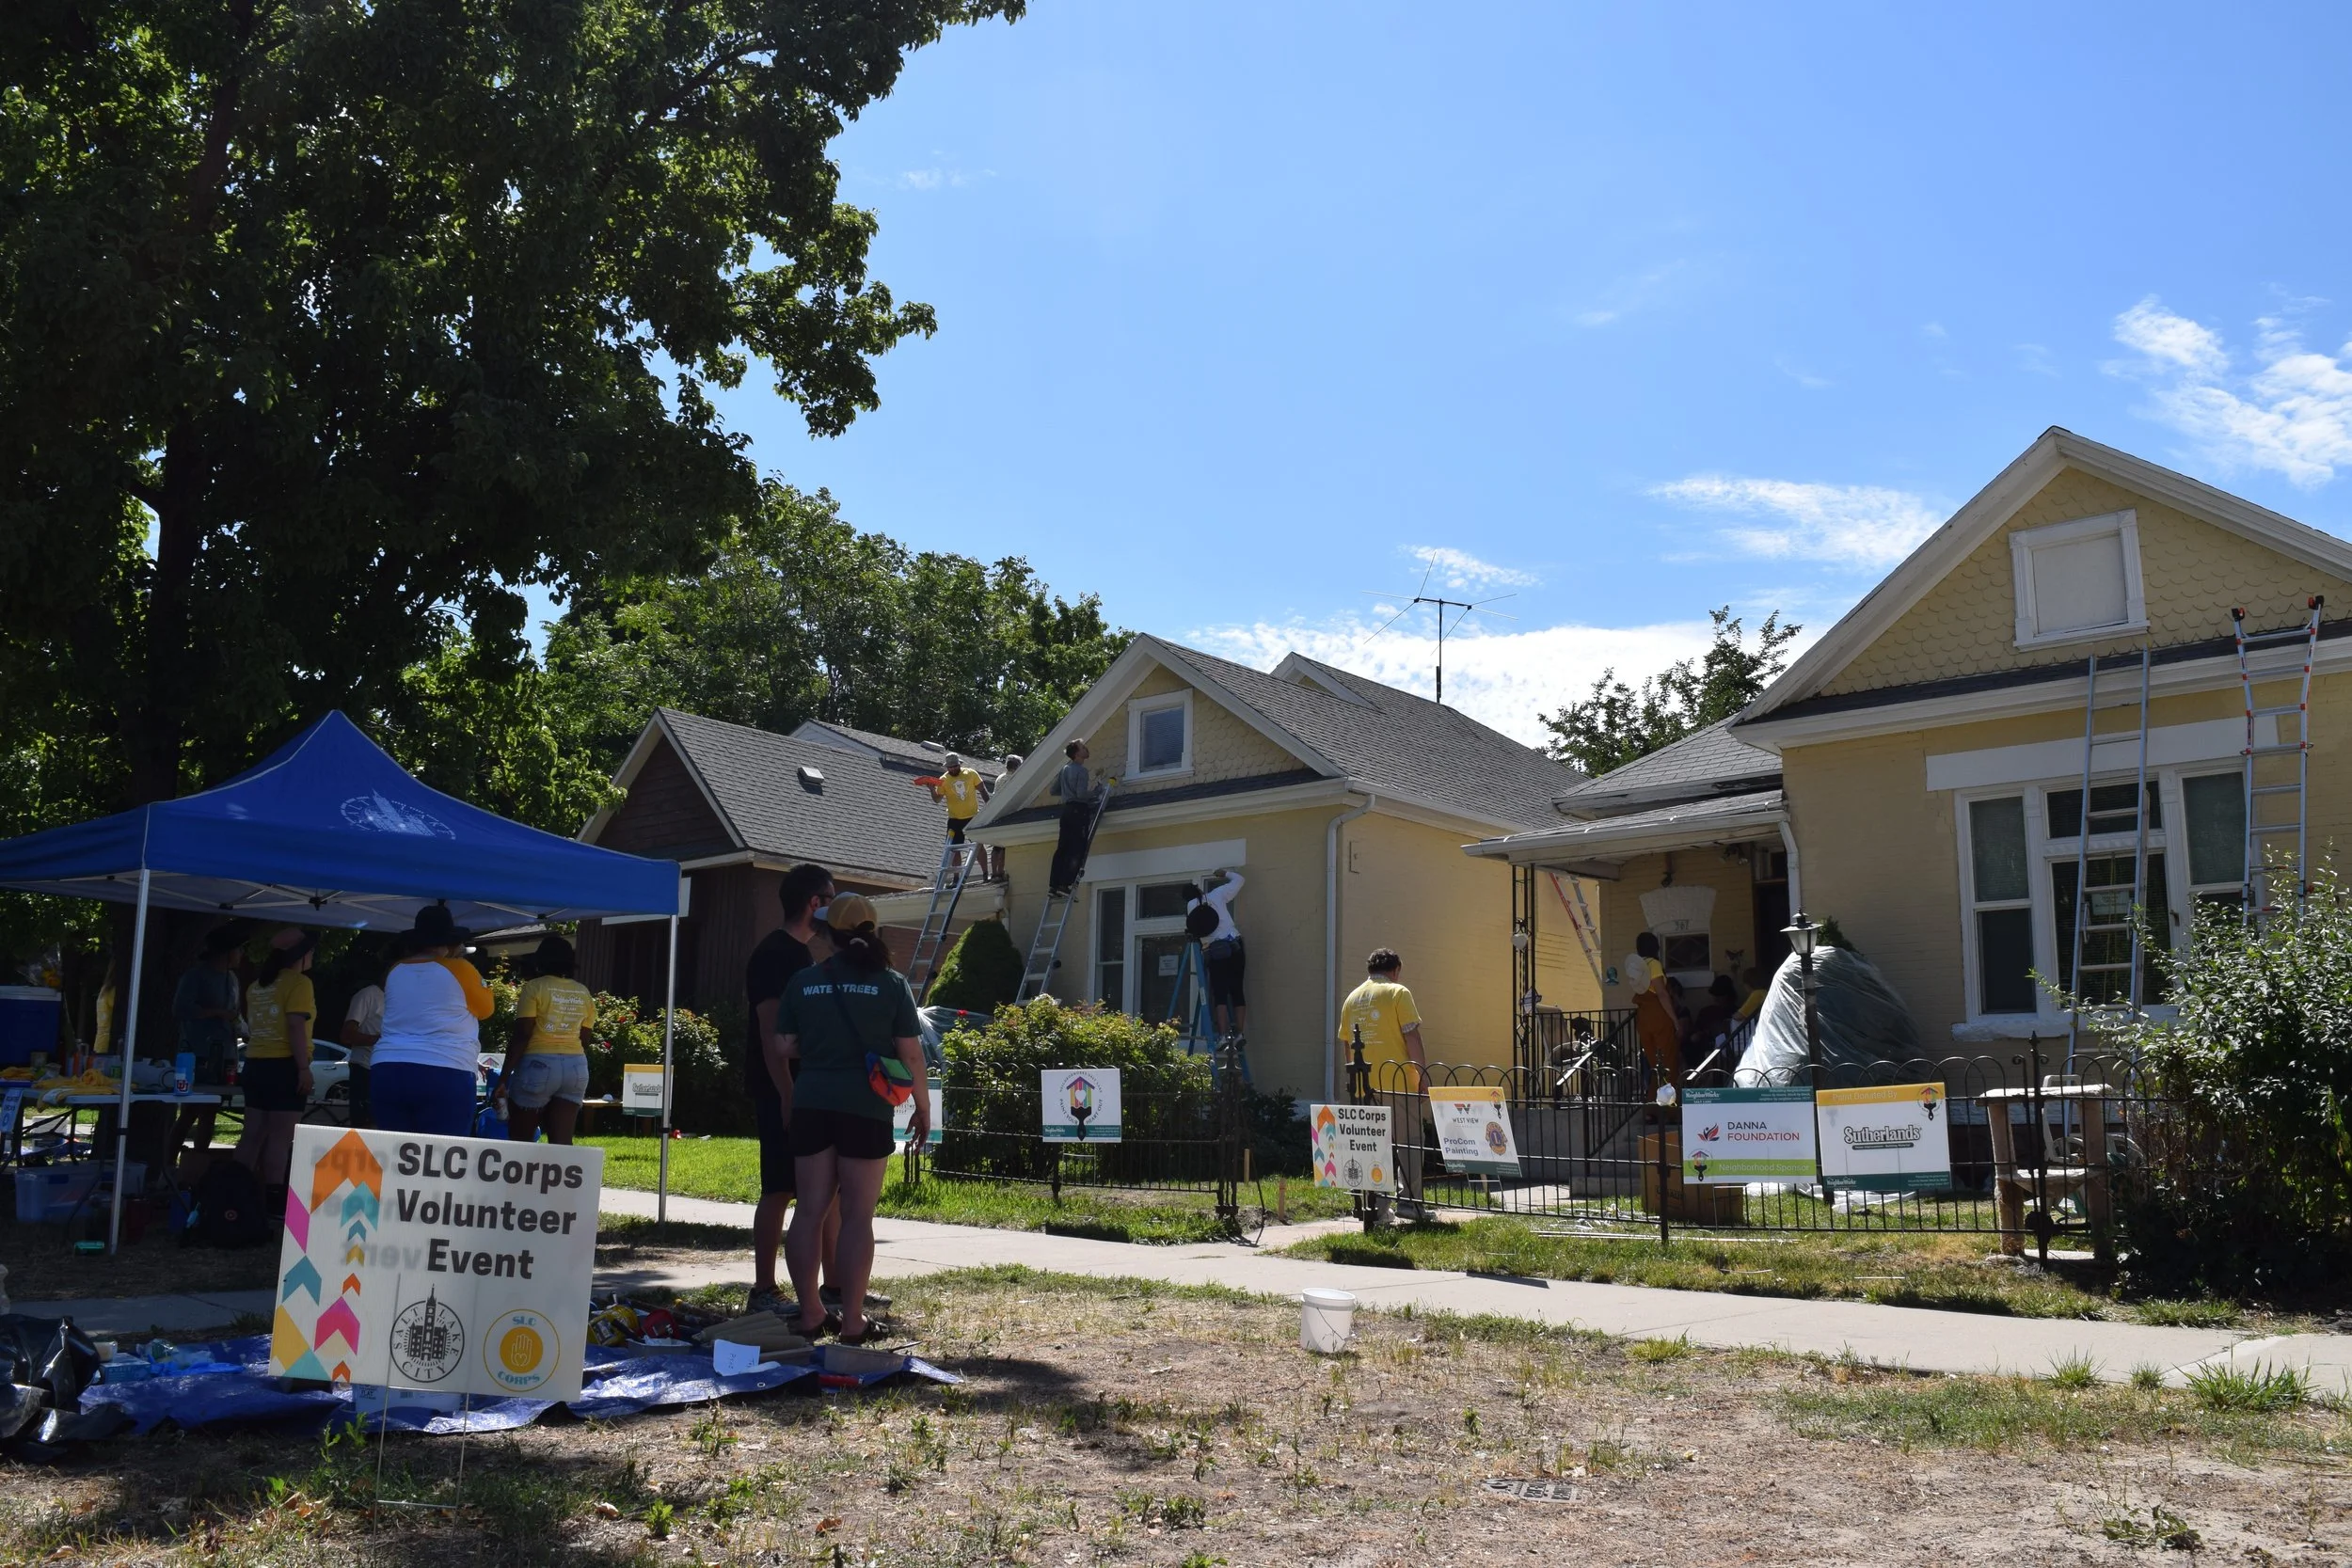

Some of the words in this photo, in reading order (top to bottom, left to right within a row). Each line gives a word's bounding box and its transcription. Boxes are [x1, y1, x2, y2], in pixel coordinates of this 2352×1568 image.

[803, 984, 840, 996] WATE
[842, 984, 879, 995] TREES
[1338, 1108, 1357, 1120] SLC
[1359, 1109, 1387, 1123] Corps
[1339, 1123, 1387, 1136] Volunteer
[1727, 1121, 1768, 1130] DANNA
[1727, 1132, 1800, 1141] FOUNDATION
[1844, 1124, 1920, 1144] Sutherlands
[1349, 1139, 1377, 1151] Event
[1445, 1147, 1479, 1157] Painting
[397, 1142, 467, 1180] SLC
[477, 1148, 583, 1194] Corps
[1719, 1164, 1775, 1173] Neighborhood
[1776, 1164, 1809, 1173] Sponsor
[396, 1189, 577, 1235] Volunteer
[427, 1238, 533, 1279] Event
[512, 1315, 536, 1326] SLC
[392, 1307, 420, 1351] SALT
[438, 1307, 461, 1356] LAKE
[402, 1361, 447, 1381] CITY
[497, 1370, 541, 1386] CORPS
